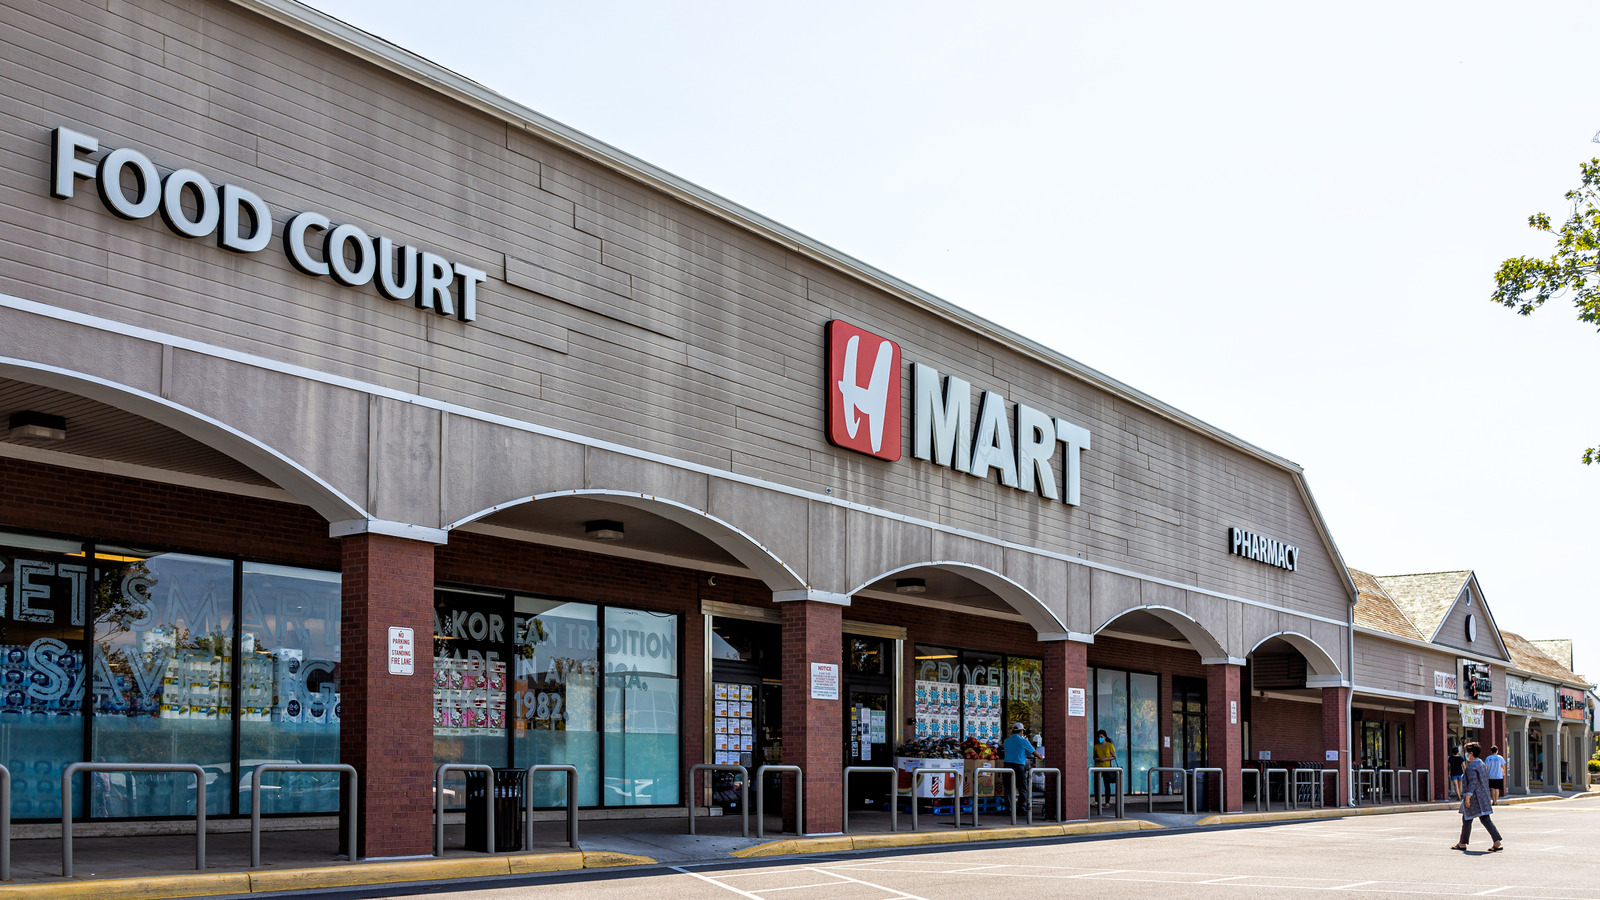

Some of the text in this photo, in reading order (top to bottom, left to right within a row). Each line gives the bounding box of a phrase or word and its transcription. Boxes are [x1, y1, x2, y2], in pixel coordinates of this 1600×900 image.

[51, 126, 487, 322] FOOD COURT
[838, 334, 1091, 506] H MART
[1228, 527, 1299, 572] PHARMACY
[0, 558, 99, 626] ET
[452, 609, 557, 647] KOREAN
[27, 637, 213, 706] SAVE
[241, 652, 336, 710] BIG
[401, 657, 411, 665] LANE
[514, 655, 539, 684] IN
[545, 657, 648, 691] AMEICA,
[514, 691, 569, 721] 1982.
